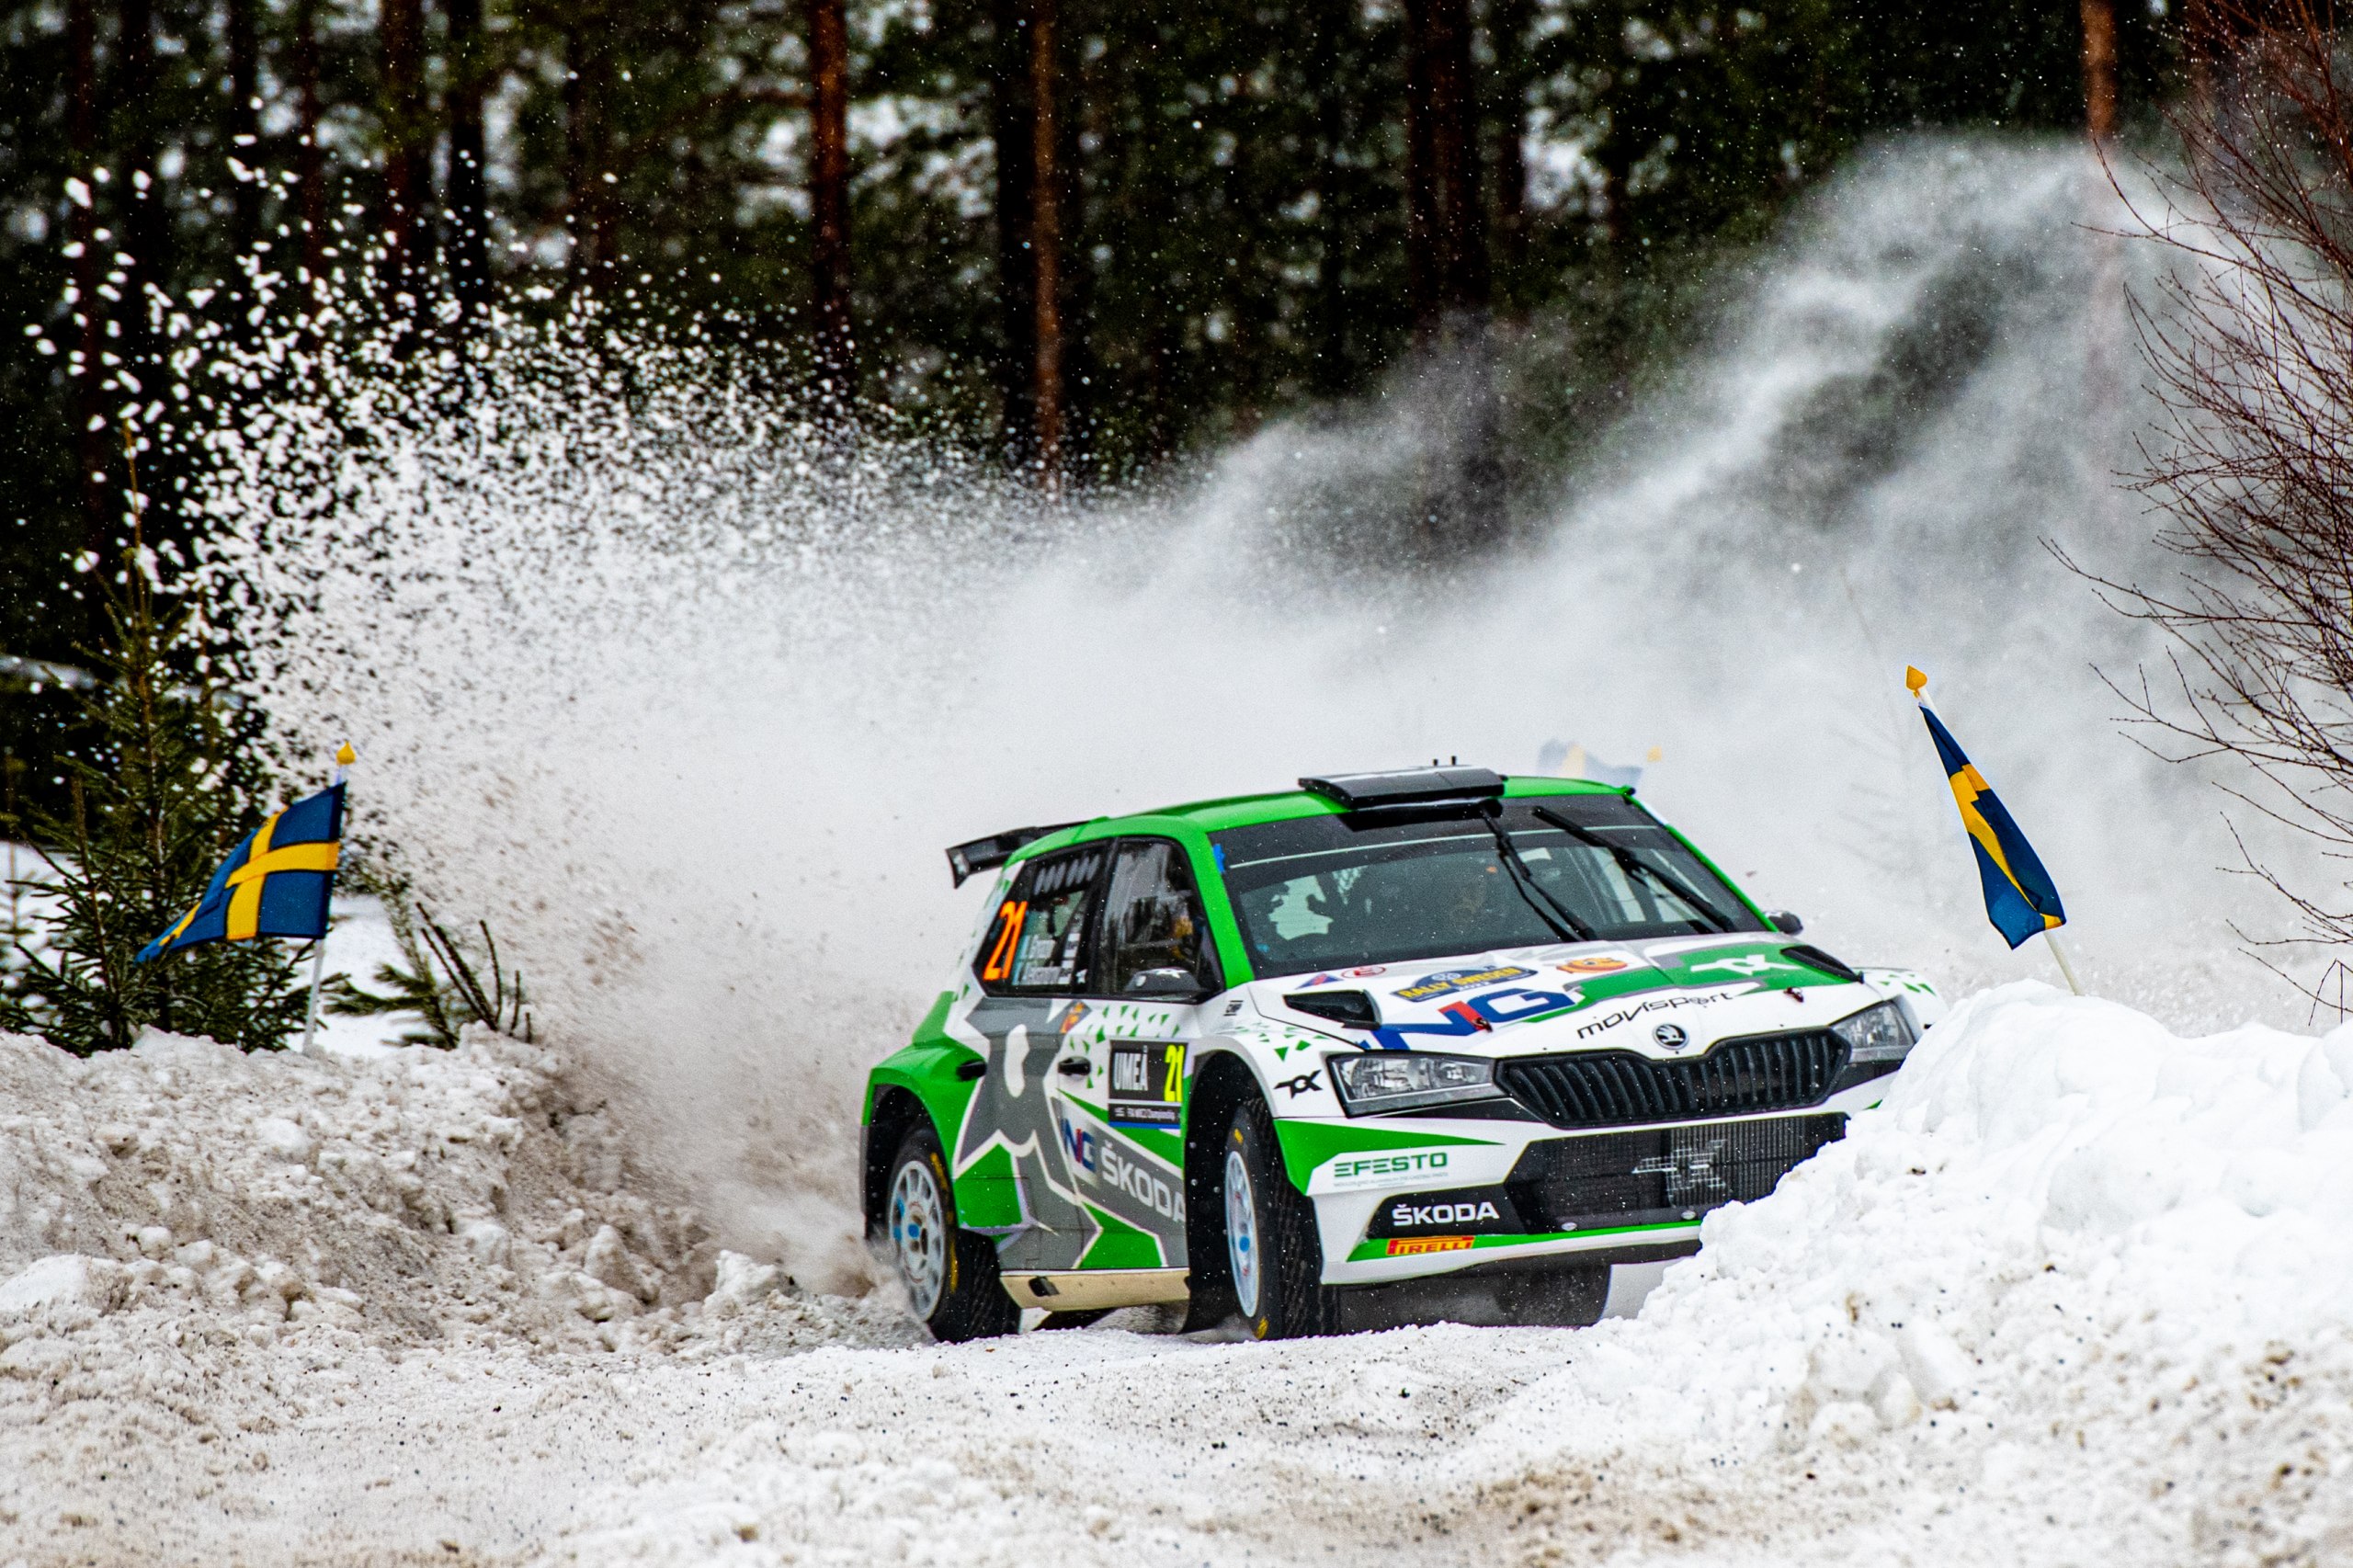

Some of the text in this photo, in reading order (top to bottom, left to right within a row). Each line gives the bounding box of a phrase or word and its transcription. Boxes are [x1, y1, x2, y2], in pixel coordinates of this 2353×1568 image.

[983, 900, 1029, 981] 21
[1113, 1044, 1149, 1092] UMEÅ
[1163, 1043, 1186, 1103] 21
[1100, 1139, 1187, 1223] ŠKODA
[1334, 1152, 1448, 1177] EFESTO
[1392, 1202, 1500, 1227] ŠKODA
[1387, 1236, 1474, 1256] PIRELLI
